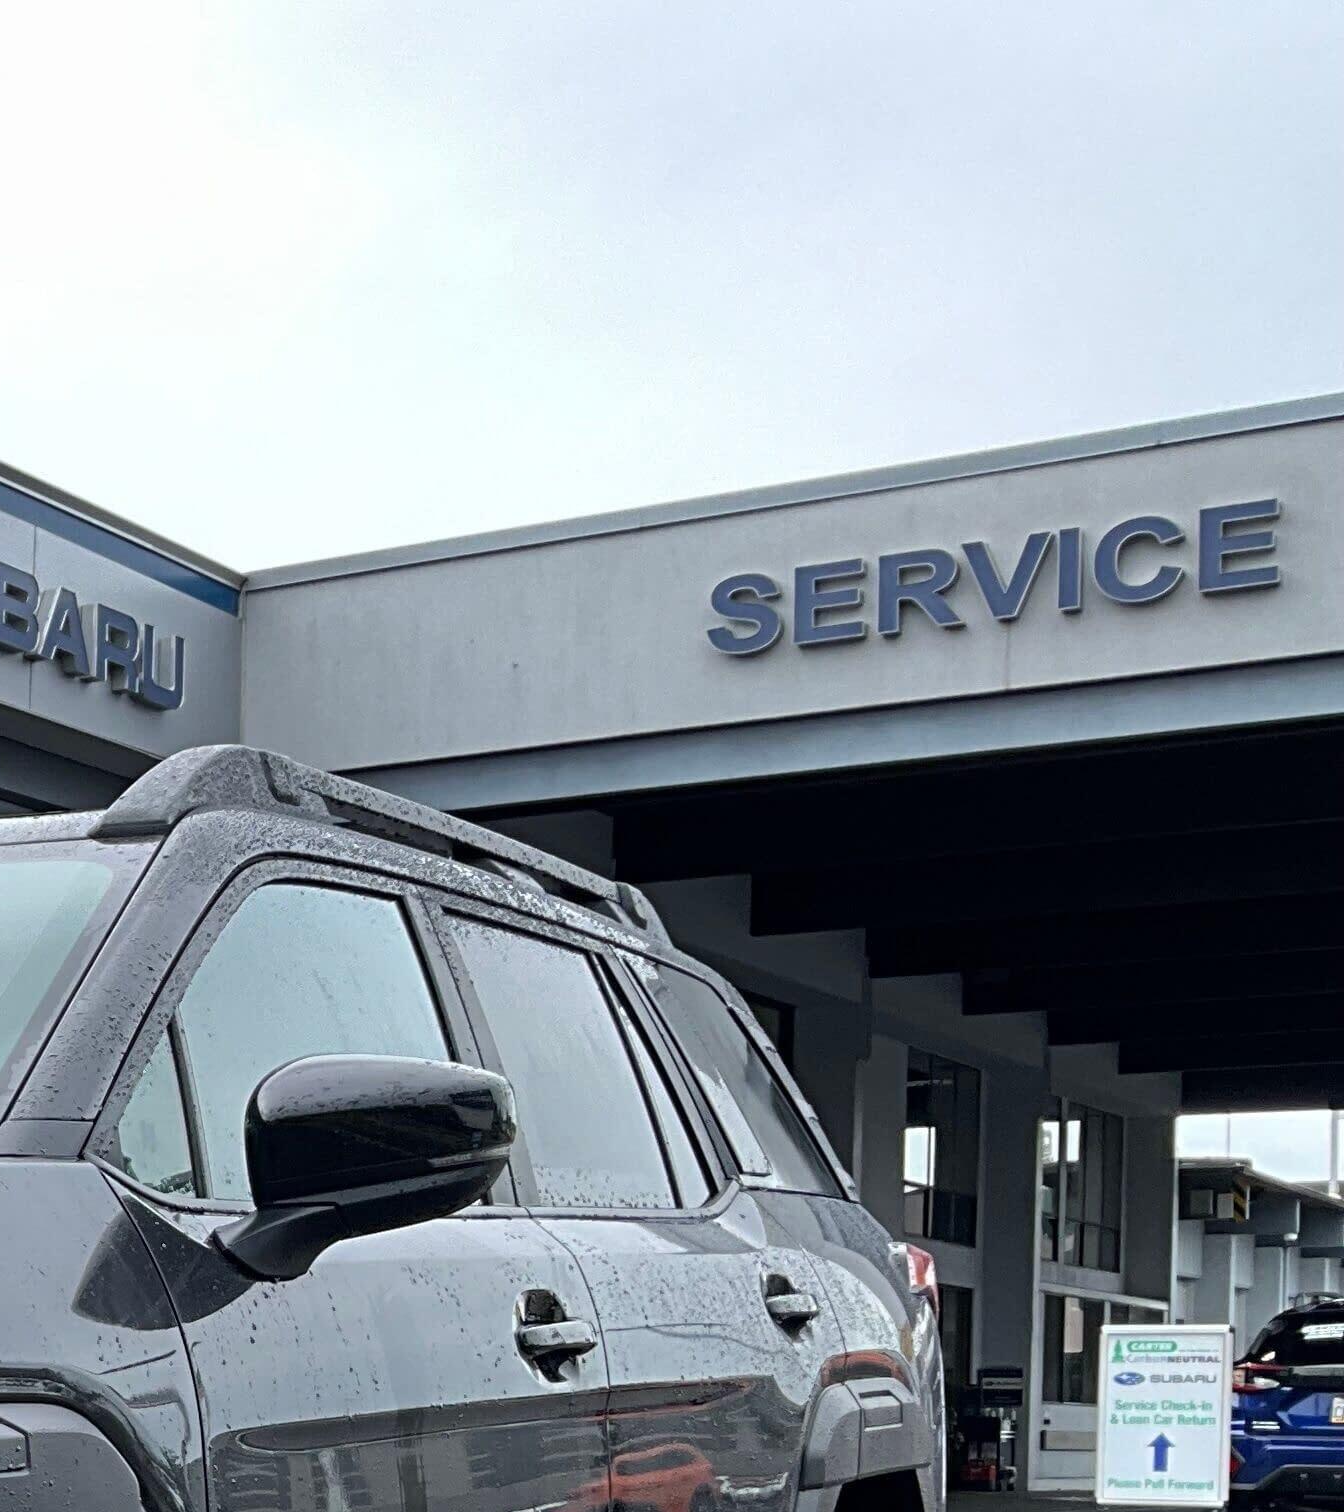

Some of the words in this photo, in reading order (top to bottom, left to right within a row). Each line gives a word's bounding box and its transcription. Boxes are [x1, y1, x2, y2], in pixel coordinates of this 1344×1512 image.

[706, 497, 1282, 655] SERVICE
[1130, 1342, 1174, 1351] CARTER
[1150, 1374, 1217, 1384] SUBARU
[1115, 1400, 1157, 1411] Service
[1161, 1400, 1213, 1411] Check-in
[1110, 1414, 1118, 1425] &
[1122, 1414, 1150, 1425] Loan
[1153, 1415, 1172, 1425] Car
[1177, 1414, 1216, 1425] Return
[1144, 1479, 1165, 1489] Pull
[1168, 1479, 1214, 1490] Forward
